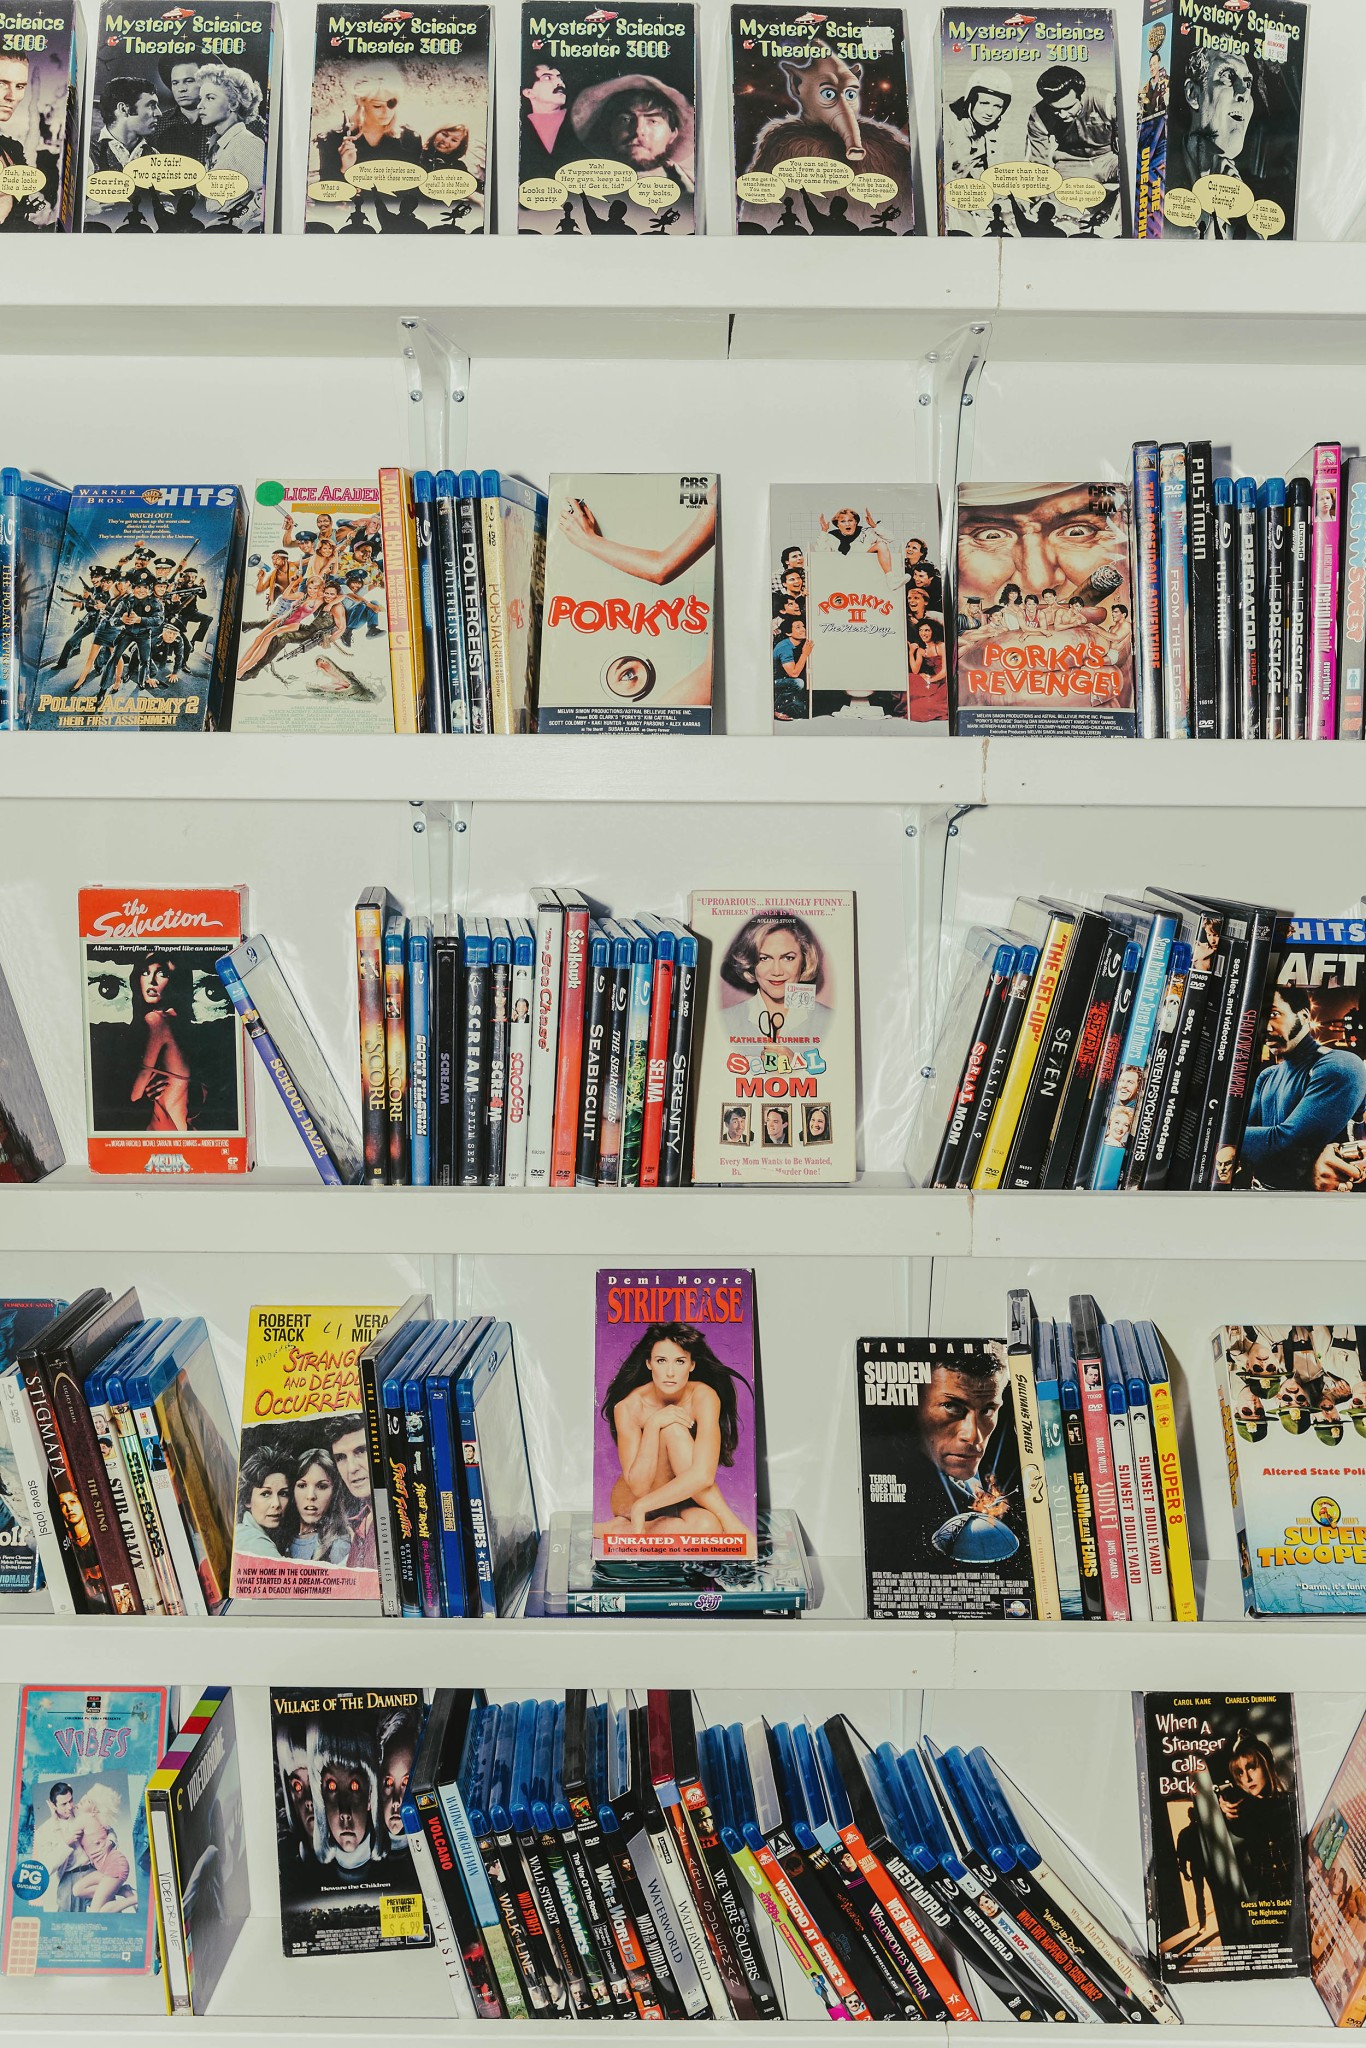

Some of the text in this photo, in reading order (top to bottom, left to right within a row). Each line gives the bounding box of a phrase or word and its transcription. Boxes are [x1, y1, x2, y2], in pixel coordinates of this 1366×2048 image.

[105, 15, 262, 36] Mystery Science
[1179, 0, 1243, 30] Mystery
[328, 16, 477, 37] Mystery Science
[529, 17, 685, 38] Mystery Science
[739, 18, 821, 39] Mystery
[948, 21, 1104, 42] Mystery Science
[2, 34, 48, 51] 3000
[122, 36, 246, 54] Theater 3000
[345, 37, 463, 55] Theater 3000
[547, 39, 671, 58] Theater 3000
[759, 40, 832, 58] Theater
[1192, 24, 1249, 56] Theater
[967, 43, 1090, 62] Theater 3000
[90, 178, 130, 188] Staring
[90, 187, 129, 195] contest!
[522, 186, 563, 196] Looks like
[535, 194, 558, 204] party.
[680, 477, 708, 492] CBS
[157, 488, 234, 506] HITS
[679, 492, 708, 505] FOX
[1192, 458, 1206, 560] POSTMAN
[1242, 534, 1256, 650] PREDATOR
[462, 543, 484, 677] POLTERGEIST
[817, 592, 894, 616] PORKY'S
[488, 584, 500, 651] POPSTAR
[548, 594, 710, 637] PORKY'S
[848, 608, 867, 623] II
[819, 623, 896, 636] The Next Day
[1268, 562, 1282, 694] THE PRESTIGE
[1170, 570, 1182, 710] FROM THE EDGE
[984, 642, 1106, 669] PORKY'S
[967, 670, 1121, 697] REVENGE!
[38, 693, 199, 713] POLICE ACADEMY 2
[58, 714, 177, 726] THEIR FIRST ASSIGNMENT
[122, 898, 148, 916] the
[765, 897, 812, 906] KILLINGLY
[814, 898, 850, 906] FUNNY...
[86, 908, 223, 943] Seduction
[1291, 922, 1365, 942] HITS
[467, 1003, 481, 1093] SCREAM
[364, 1039, 386, 1111] SCORE
[440, 1052, 450, 1105] SCREAM
[582, 1023, 604, 1141] SEABISCUIT
[607, 1029, 621, 1124] THE SEARCHERS
[647, 1058, 665, 1104] SELMA
[509, 1051, 524, 1124] SCROOGED
[735, 1077, 818, 1098] MOM
[269, 1056, 328, 1159] SCHOOL DAZE
[665, 1053, 687, 1154] SERENITY
[1134, 1048, 1167, 1162] SEVEN PSYCHOPATHS
[144, 1153, 191, 1173] MEDIA
[720, 1157, 740, 1166] Every
[761, 1157, 783, 1166] Wants
[804, 1157, 833, 1167] Wanted,
[608, 1276, 742, 1285] Demi Moore
[607, 1287, 744, 1324] STRIPTEASE
[258, 1314, 389, 1328] ROBERT VERA
[264, 1328, 304, 1342] STACK
[864, 1362, 931, 1384] SUDDEN
[865, 1384, 919, 1405] DEATH
[1014, 1374, 1034, 1456] SULLIVAN'S TRAVELS
[25, 1375, 67, 1479] STIGMATA
[869, 1474, 896, 1484] TERROR
[1263, 1468, 1340, 1476] Altered State
[28, 1480, 41, 1508] steve
[870, 1483, 907, 1494] GOES INTO
[871, 1493, 906, 1502] OVERTIME
[1161, 1452, 1183, 1525] SUPER 8
[88, 1478, 108, 1532] THE STING
[110, 1478, 144, 1570] STIR CRAZY
[470, 1498, 486, 1549] STRIPES
[1118, 1464, 1142, 1585] SUNSET BOULEVARD
[607, 1536, 743, 1544] UNRATED VERSION
[274, 1692, 418, 1715] VILLAGE OF THE DAMNED
[1173, 1695, 1277, 1706] CAROL KANE CHARLES DURNING
[1155, 1713, 1212, 1735] When A
[54, 1727, 132, 1758] VIBES
[1162, 1736, 1226, 1755] Stranger
[1171, 1757, 1206, 1773] calls
[1159, 1776, 1197, 1795] Back
[428, 1816, 453, 1872] VOLCANO
[19, 1869, 42, 1884] PG
[529, 1855, 560, 1925] WALL STREET
[885, 1856, 950, 1927] WESTWORLD
[158, 1871, 180, 1951] VIDEODROME
[499, 1893, 521, 1936] WALK
[552, 1866, 590, 1955] WARGAMES
[648, 1878, 683, 1963] WATERWORLD
[775, 1878, 809, 1927] WEEKEND
[804, 1928, 819, 1941] AT
[714, 1869, 760, 1980] WE WERE SOLDIERS
[899, 1918, 922, 1941] SIDE
[911, 1939, 935, 1963] STORY
